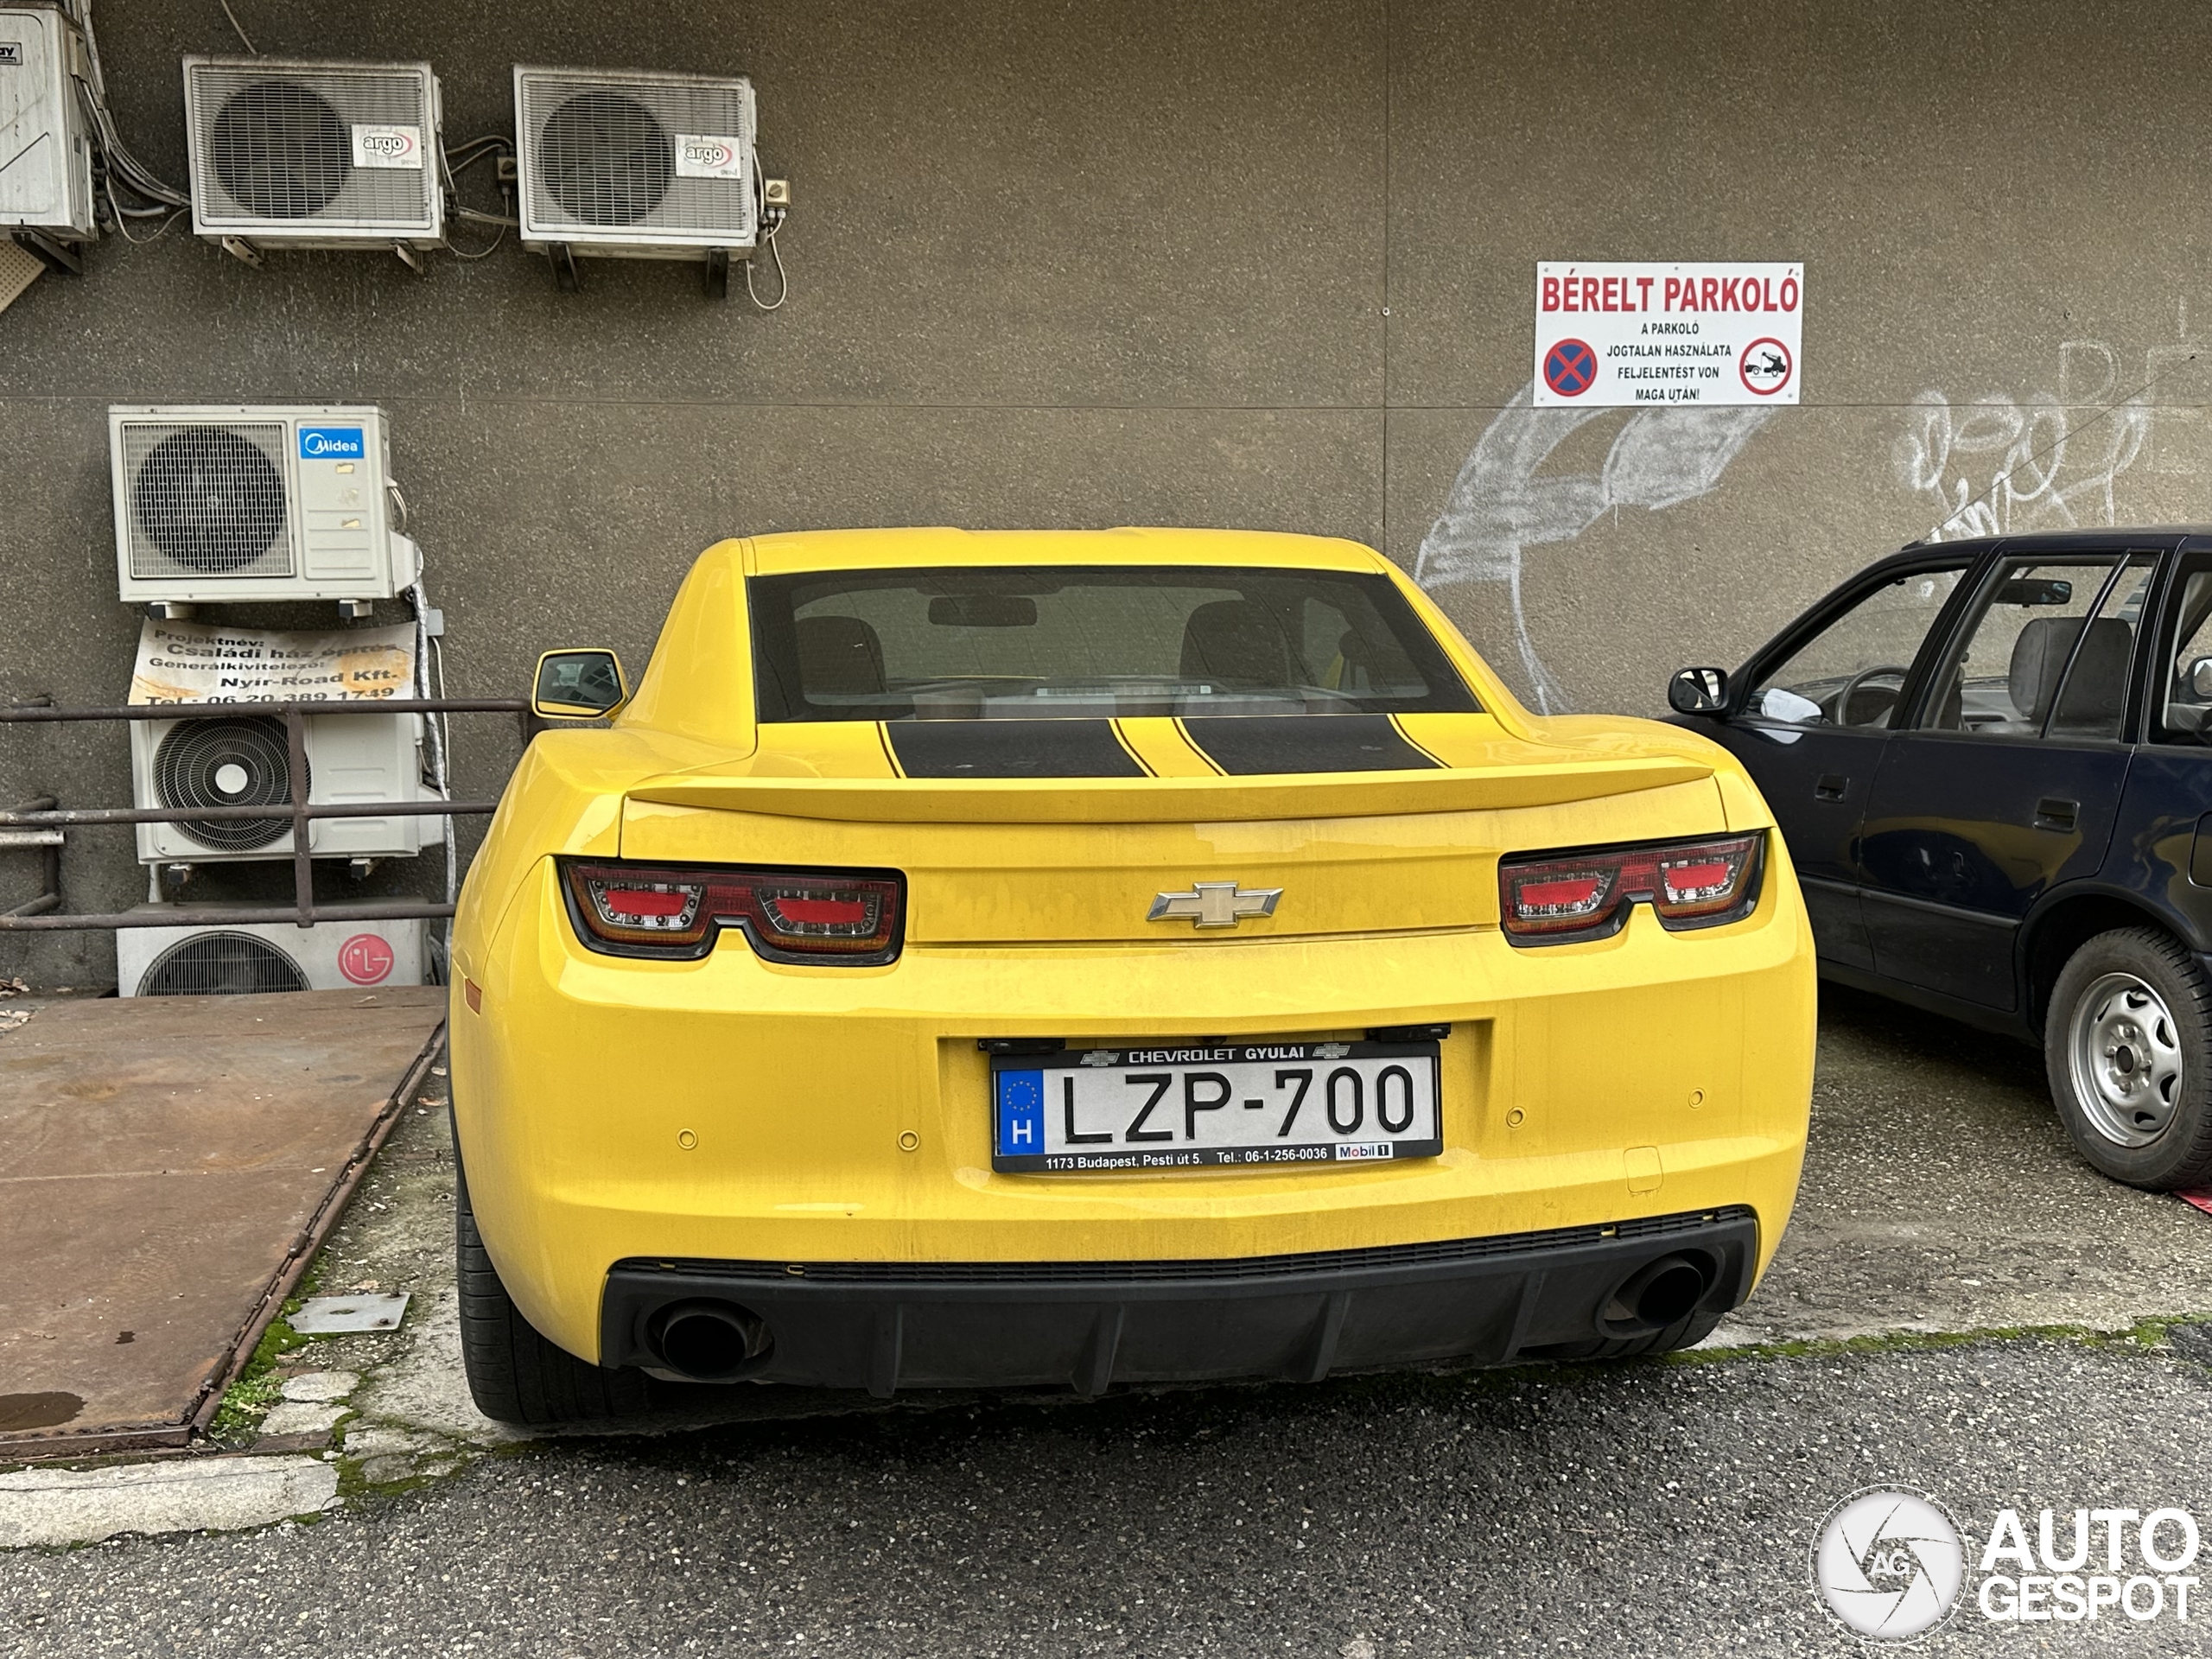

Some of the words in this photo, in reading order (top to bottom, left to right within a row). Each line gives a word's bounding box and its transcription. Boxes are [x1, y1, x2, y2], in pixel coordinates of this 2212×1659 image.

[363, 136, 404, 156] argo
[685, 146, 723, 169] argo
[1542, 269, 1654, 312] BÉRELT
[1664, 269, 1798, 312] PARKOLÓ
[1641, 323, 1649, 334] A
[1651, 320, 1699, 334] PARKOLÓ
[1606, 345, 1662, 357] JOGTALAN
[1665, 342, 1732, 357] HASZNÁLATA
[1618, 364, 1694, 379] FELJELENTÉST
[1698, 366, 1719, 378] VON
[1636, 389, 1665, 400] MAGA
[1668, 385, 1700, 400] UTÁN!
[305, 433, 359, 454] Midea
[154, 629, 264, 647] Projektnév:
[166, 644, 261, 658] Családi
[220, 673, 344, 689] Nyír-Road
[353, 670, 397, 681] Kft.
[246, 694, 275, 702] 20
[283, 692, 327, 702] 389
[337, 688, 395, 701] 1749
[342, 938, 390, 982] LG
[1128, 1048, 1236, 1063] CHEVROLET
[1245, 1046, 1304, 1059] GYULAI
[1063, 1064, 1414, 1144] LZP-700
[1012, 1119, 1032, 1144] H
[1046, 1158, 1074, 1169] 1173
[1077, 1155, 1140, 1169] Budapest,
[1143, 1154, 1173, 1166] Pesti
[1177, 1153, 1190, 1165] út
[1192, 1153, 1203, 1165] 5.
[1217, 1151, 1242, 1163] Tel.:
[1245, 1147, 1327, 1162] 06-1-256-0036
[1339, 1146, 1375, 1158] Mobil
